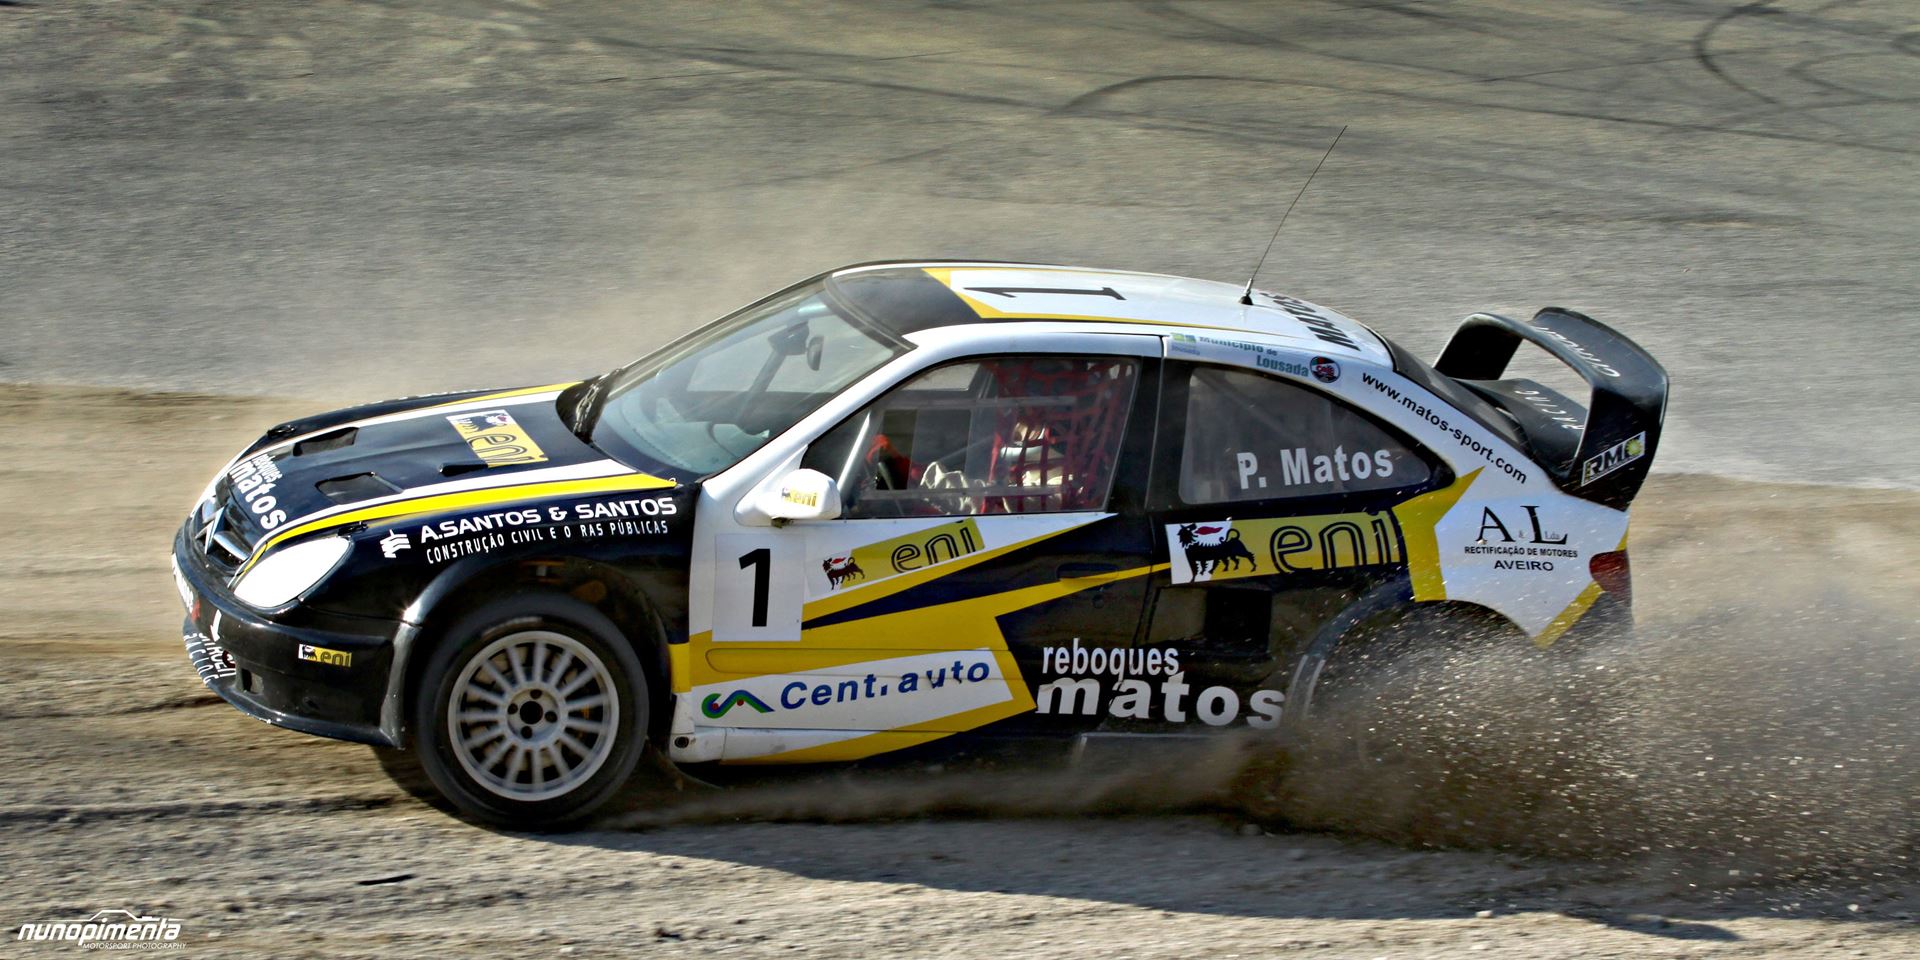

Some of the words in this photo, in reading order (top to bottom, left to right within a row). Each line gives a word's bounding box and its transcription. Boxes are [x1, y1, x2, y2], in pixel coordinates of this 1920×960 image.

[1256, 355, 1310, 377] Lousada
[1362, 372, 1528, 484] www.matos-sport.com
[1237, 451, 1267, 490] P.
[1280, 444, 1394, 486] Matos
[229, 460, 287, 530] matos
[420, 508, 542, 544] A.SANTOS
[548, 506, 567, 521] &
[575, 497, 677, 519] SANTOS
[426, 532, 505, 565] CONSTRUÇÃO
[511, 528, 544, 544] CIVIL
[549, 526, 557, 539] E
[609, 519, 669, 536] PÚBLICAS
[1269, 512, 1394, 574] eni
[891, 519, 977, 574] eni
[1494, 560, 1554, 571] AVEIRO
[1527, 547, 1538, 556] DE
[1539, 548, 1578, 558] MOTORES
[738, 548, 771, 627] 1
[320, 651, 352, 667] eni
[1042, 637, 1180, 682] reboques
[1036, 671, 1286, 728] matos
